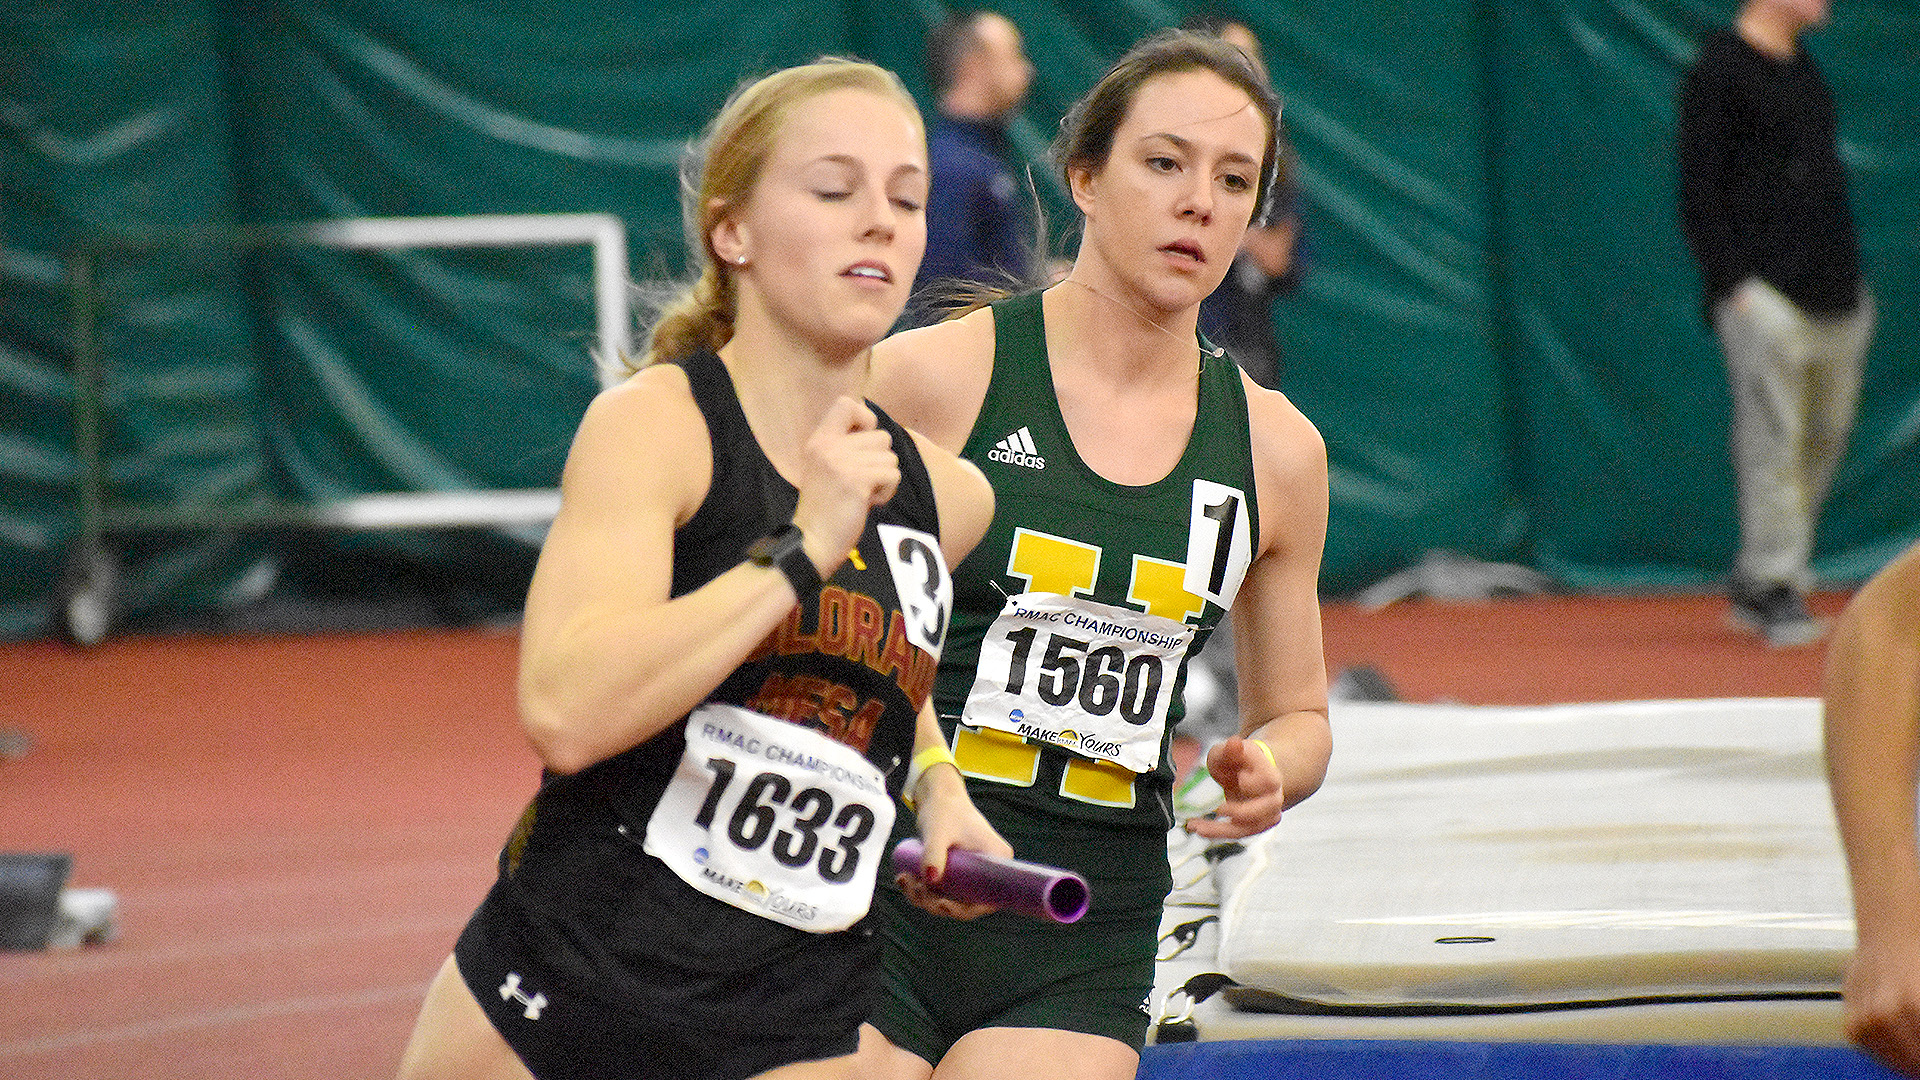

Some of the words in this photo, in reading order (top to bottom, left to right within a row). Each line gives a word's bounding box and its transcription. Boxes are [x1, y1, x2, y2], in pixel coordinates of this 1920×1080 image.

[987, 447, 1046, 470] adidas
[1203, 494, 1240, 597] 1
[1013, 607, 1062, 623] RMAC
[1063, 612, 1183, 650] CHAMPIONSHIP
[1004, 626, 1163, 726] 1560
[703, 722, 760, 755] RMAC
[1017, 723, 1060, 744] MAKE
[694, 757, 876, 886] 1633
